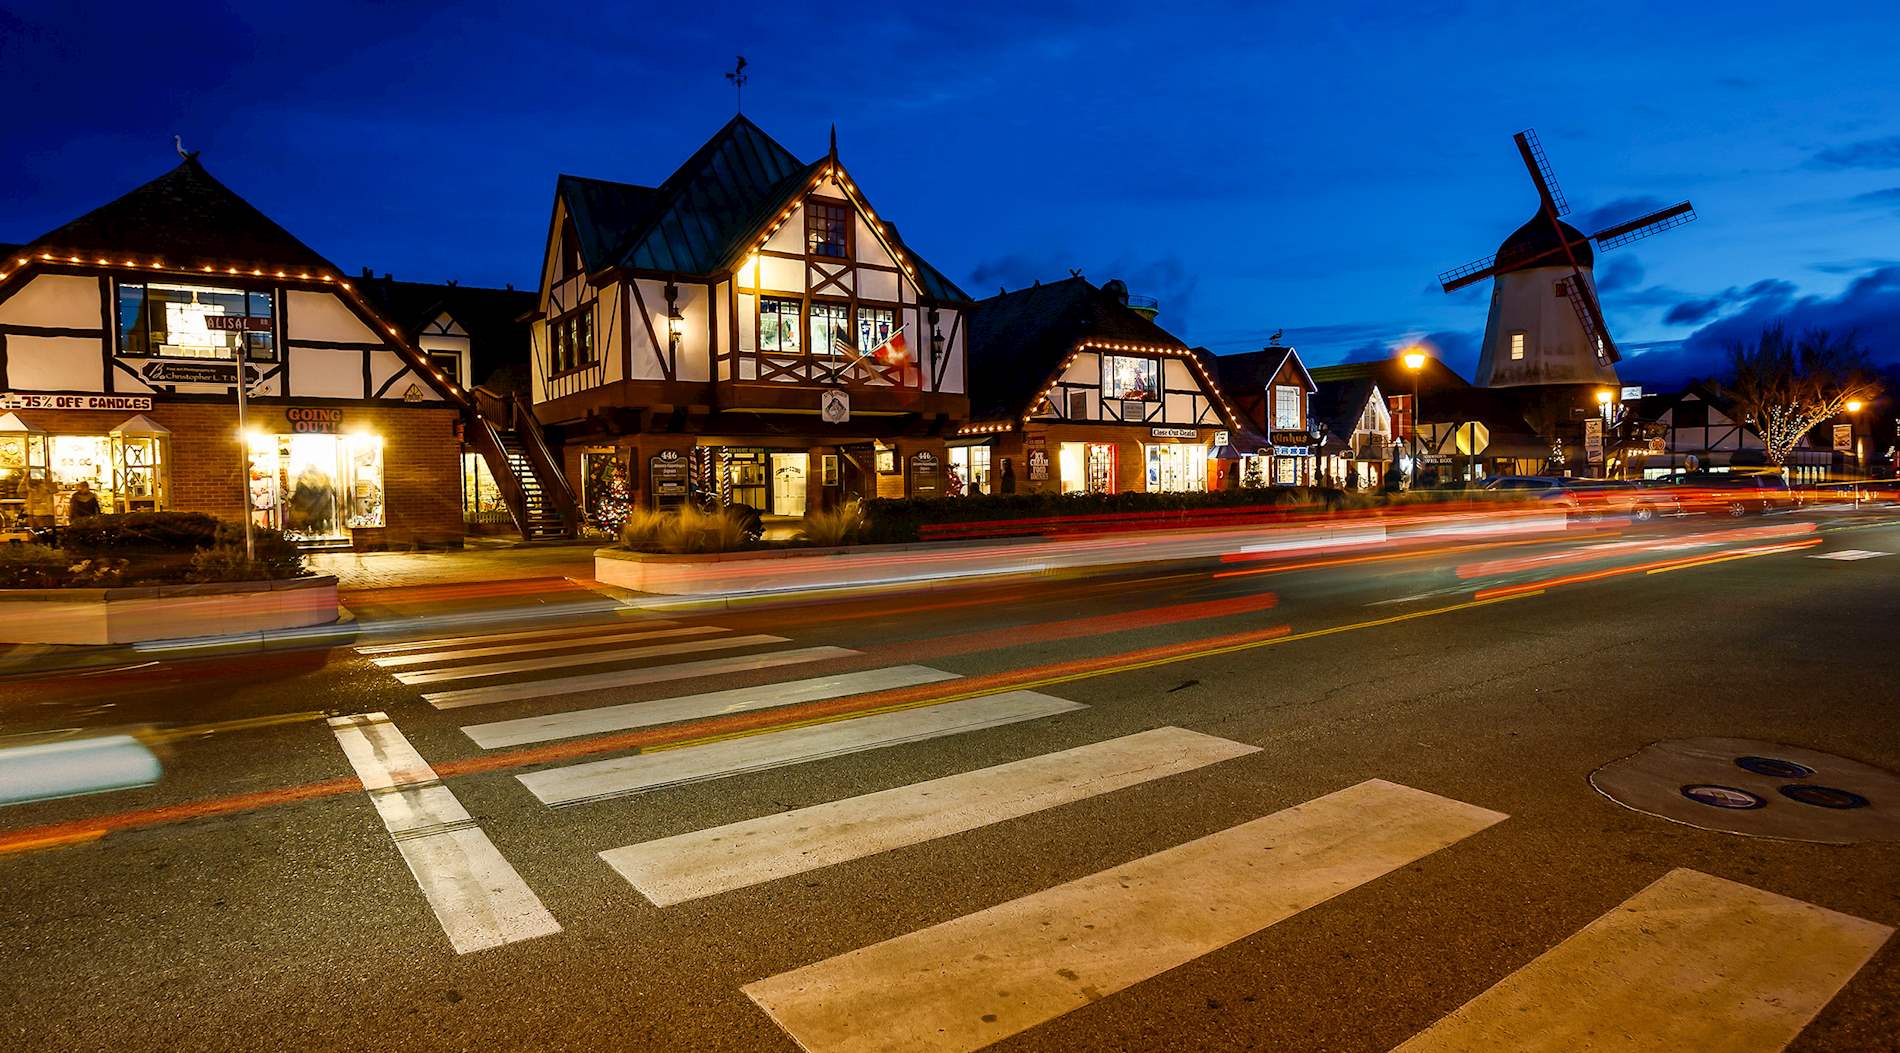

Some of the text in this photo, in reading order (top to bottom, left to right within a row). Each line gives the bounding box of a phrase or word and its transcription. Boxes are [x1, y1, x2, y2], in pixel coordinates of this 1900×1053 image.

[207, 318, 250, 330] ALISAL
[165, 371, 212, 382] Christopher
[22, 396, 150, 409] 75% OFF CANDLES
[288, 408, 341, 421] GOING
[661, 451, 677, 460] 446
[918, 452, 931, 460] 446
[1030, 459, 1049, 467] CREAM
